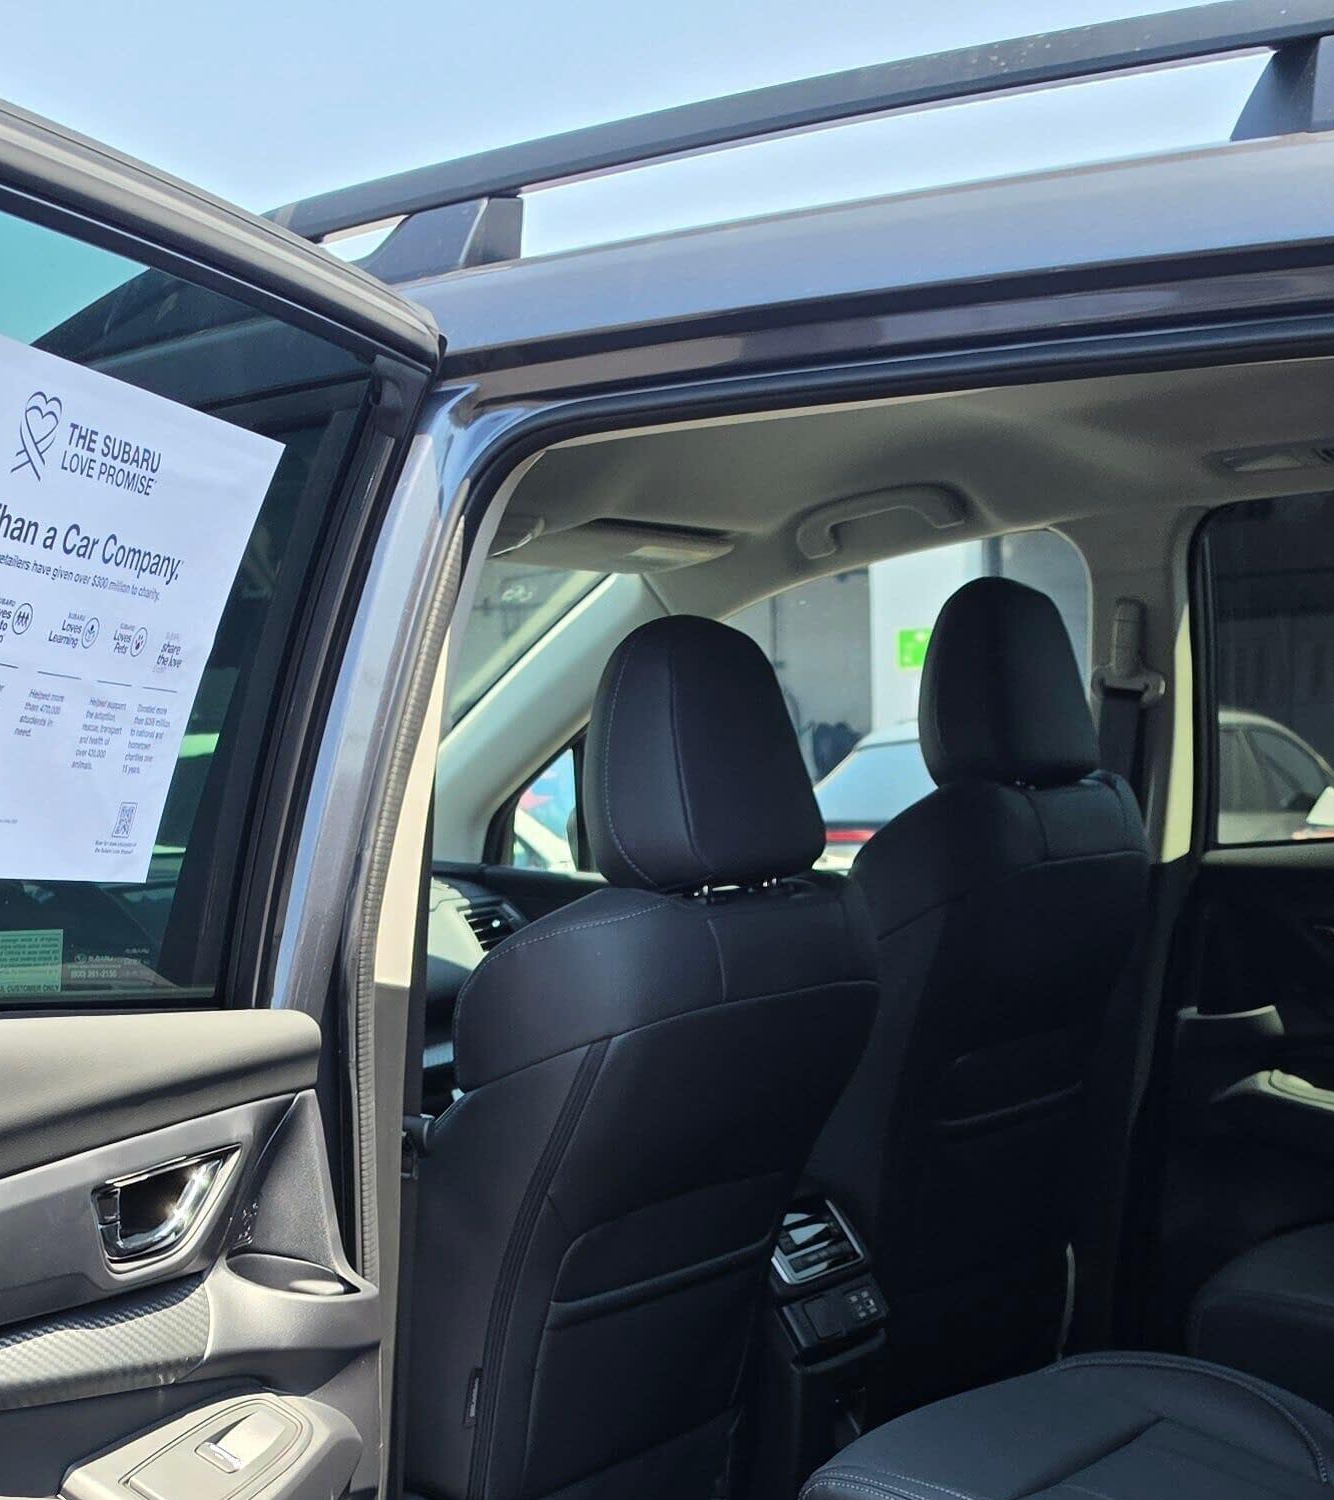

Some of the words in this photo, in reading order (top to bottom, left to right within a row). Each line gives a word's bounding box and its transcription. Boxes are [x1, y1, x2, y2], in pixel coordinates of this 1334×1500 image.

[68, 422, 98, 453] THE
[101, 434, 161, 473] SUBARU
[61, 450, 96, 478] LOVE
[98, 462, 155, 496] PROMISE
[42, 526, 57, 550] a
[62, 524, 99, 560] Car
[31, 560, 51, 576] have
[52, 567, 73, 581] given
[74, 572, 91, 584] over
[91, 575, 108, 589] $300
[108, 580, 130, 594] million
[130, 584, 138, 596] to
[61, 620, 82, 634] Loves
[48, 630, 78, 649] Learning
[113, 630, 132, 643] Loves
[113, 642, 128, 654] Pets
[161, 641, 182, 655] share
[157, 654, 168, 666] the
[168, 656, 183, 668] love
